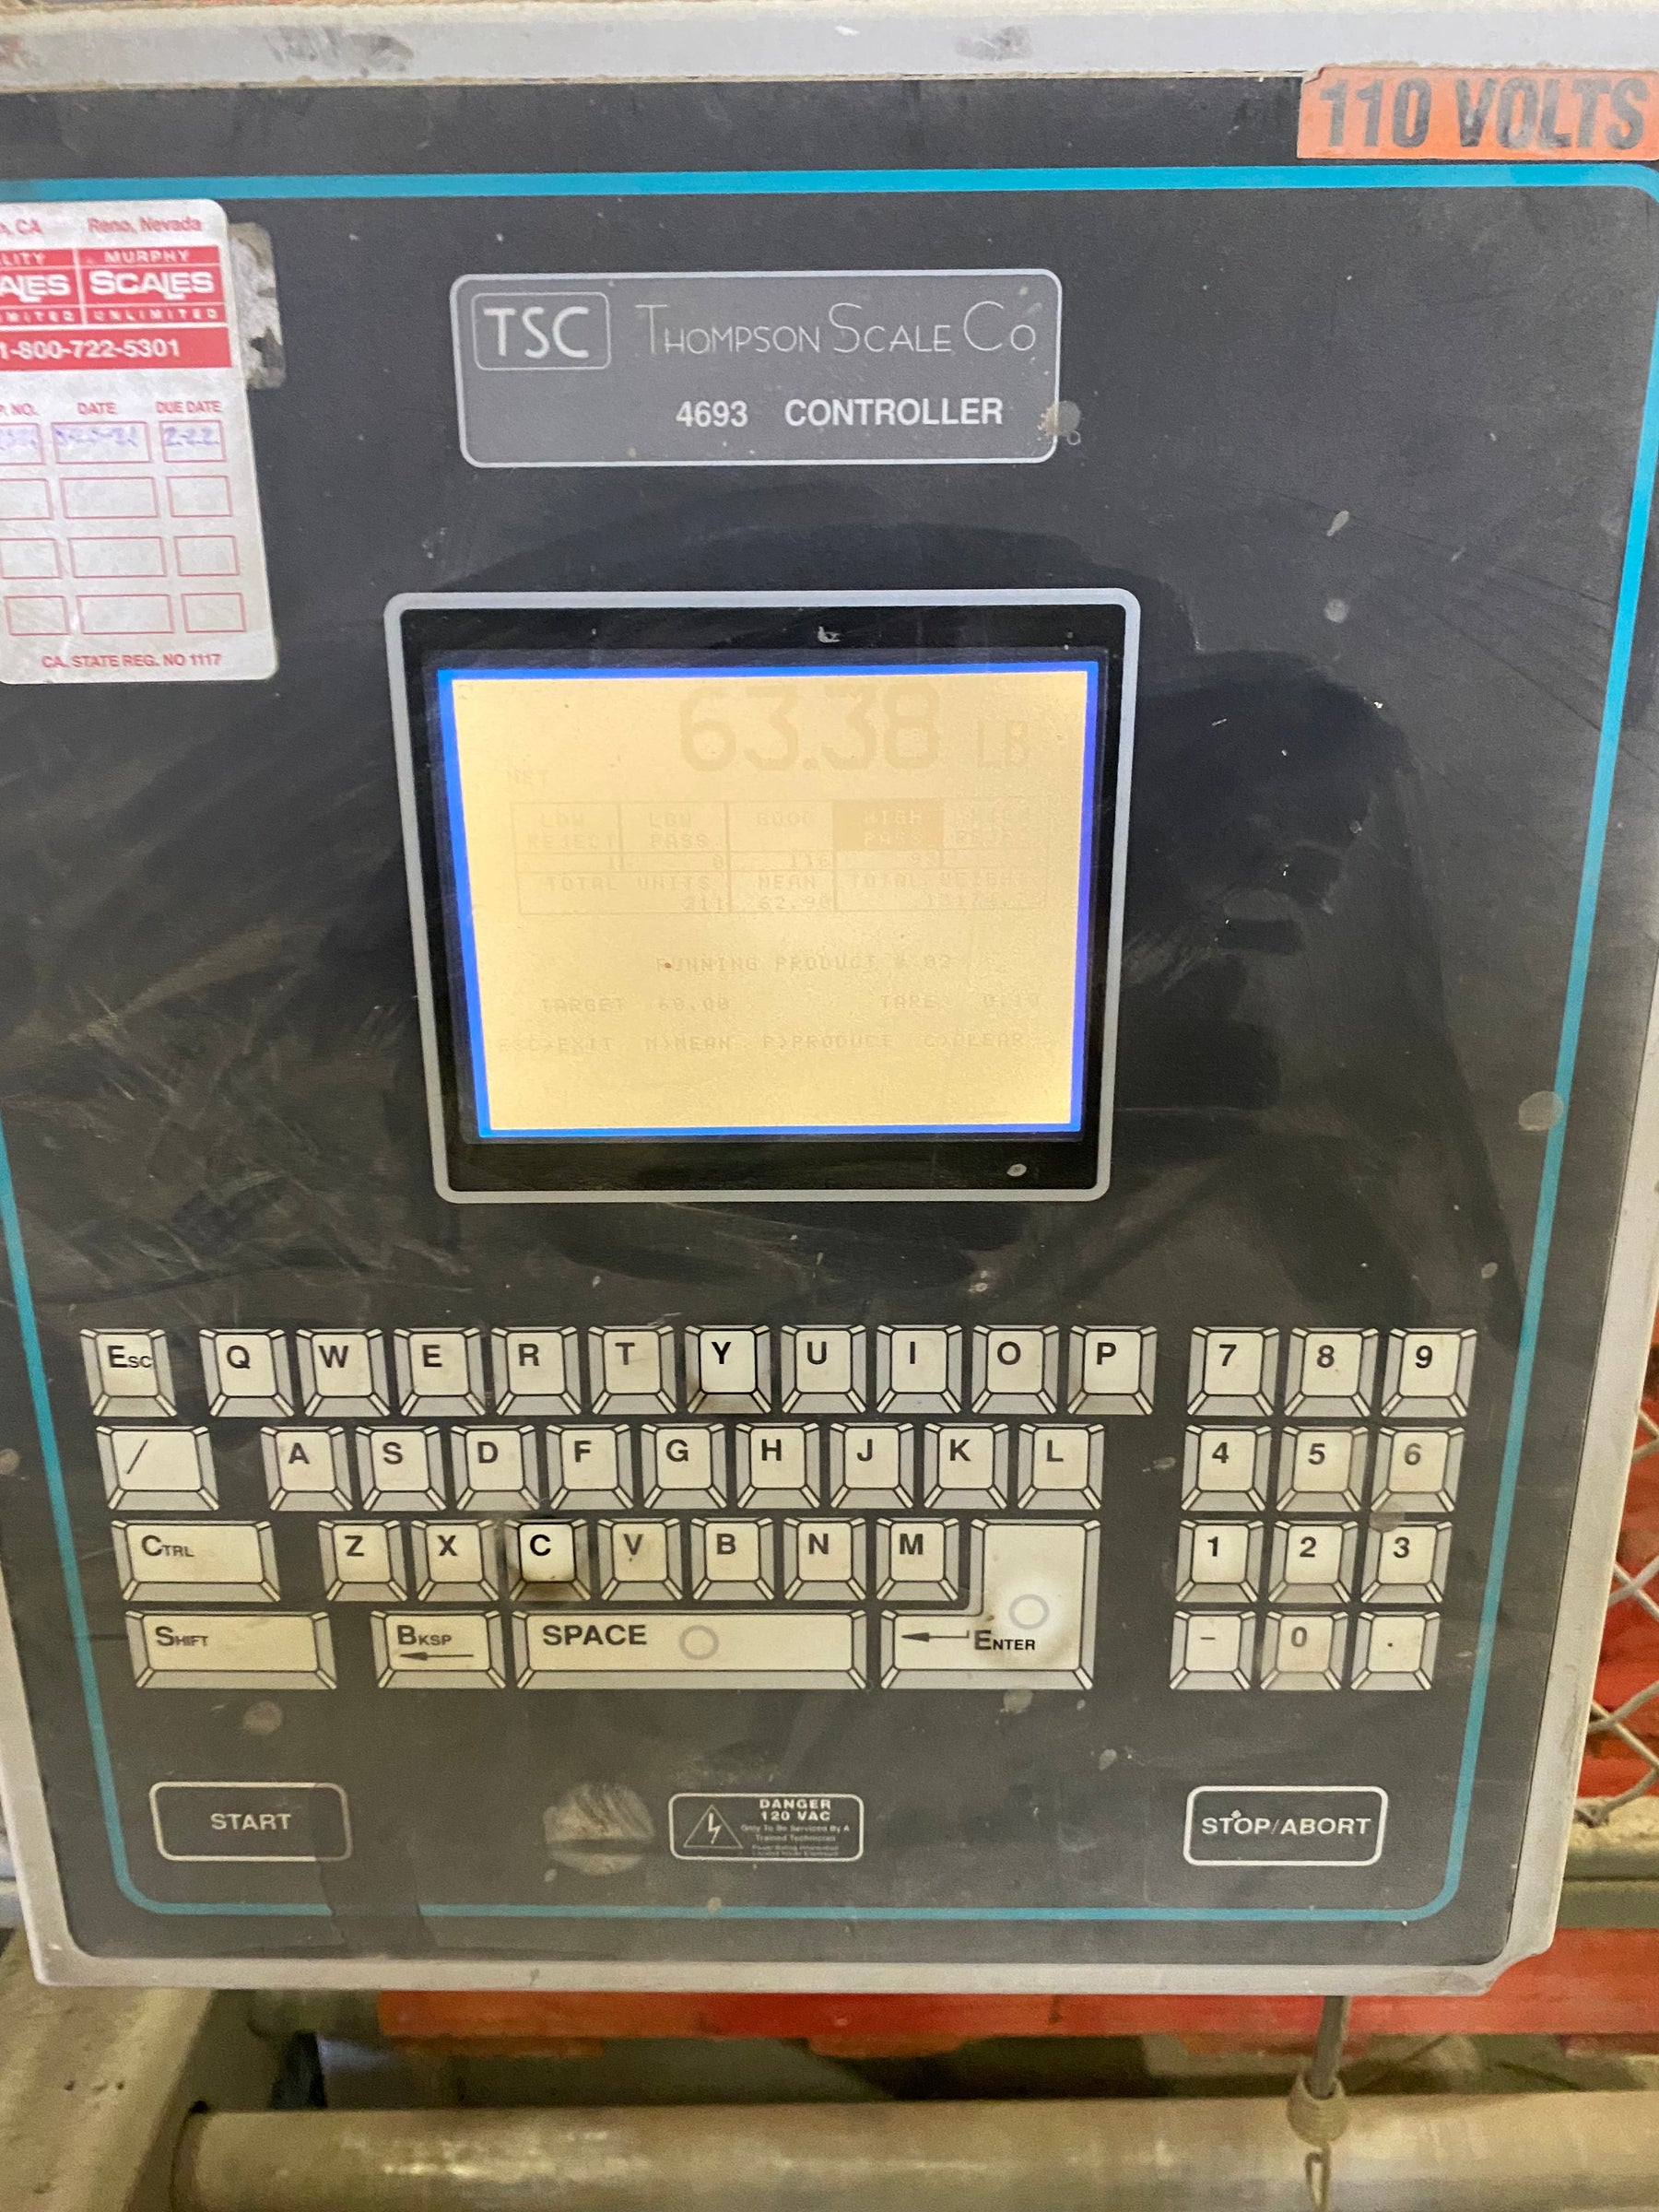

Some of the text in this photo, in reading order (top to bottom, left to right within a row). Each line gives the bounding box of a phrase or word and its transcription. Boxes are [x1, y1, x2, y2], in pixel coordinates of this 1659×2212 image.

[1320, 77, 1650, 150] 110 VOLTS
[140, 217, 202, 232] Nevada
[0, 252, 45, 266] LITY
[104, 249, 190, 265] MURPHY
[0, 274, 71, 303] ALES
[89, 269, 215, 301] SCALES
[93, 308, 218, 322] UNLIMITED
[484, 307, 589, 359] TSC
[0, 338, 180, 360] 1-800-722-5301
[77, 402, 117, 415] DATE
[156, 400, 221, 414] DUE DATE
[675, 397, 1004, 428] 4693 CONTROLLER
[41, 653, 221, 668] CA. STATE REG. NO 1117
[679, 686, 1029, 771] 63.38 LB
[863, 809, 922, 826] HIGH
[650, 833, 709, 849] PASS
[775, 955, 877, 971] PRODUCT
[226, 1345, 251, 1370] Q
[318, 1345, 349, 1369] W
[421, 1344, 443, 1368] E
[518, 1343, 540, 1367] R
[614, 1342, 636, 1366] T
[711, 1341, 732, 1365] Y
[806, 1341, 828, 1366] U
[909, 1341, 916, 1365] I
[996, 1340, 1021, 1366] O
[1096, 1342, 1117, 1366] P
[1218, 1343, 1238, 1367] 7
[1316, 1344, 1335, 1369] 8
[1415, 1345, 1433, 1370] 9
[288, 1441, 311, 1465] A
[382, 1441, 404, 1465] S
[477, 1441, 499, 1464] D
[573, 1440, 592, 1463] F
[665, 1439, 689, 1463] G
[761, 1438, 782, 1462] H
[856, 1438, 873, 1462] J
[949, 1438, 971, 1462] K
[1046, 1439, 1065, 1463] L
[1211, 1441, 1230, 1465] 4
[1308, 1442, 1325, 1465] 5
[1404, 1442, 1422, 1466] 6
[344, 1535, 365, 1558] Z
[437, 1535, 458, 1557] X
[529, 1534, 551, 1557] C
[623, 1533, 643, 1556] V
[716, 1533, 736, 1556] B
[808, 1533, 830, 1555] N
[899, 1533, 924, 1556] M
[1207, 1535, 1218, 1558] 1
[1299, 1535, 1317, 1559] 2
[1393, 1536, 1410, 1559] 3
[542, 1624, 648, 1646] SPACE
[1290, 1626, 1308, 1648] 0
[759, 1798, 831, 1809] DANGER
[210, 1813, 291, 1830] START
[760, 1810, 830, 1821] 120 VAC
[1201, 1818, 1371, 1835] STOP/ABORT
